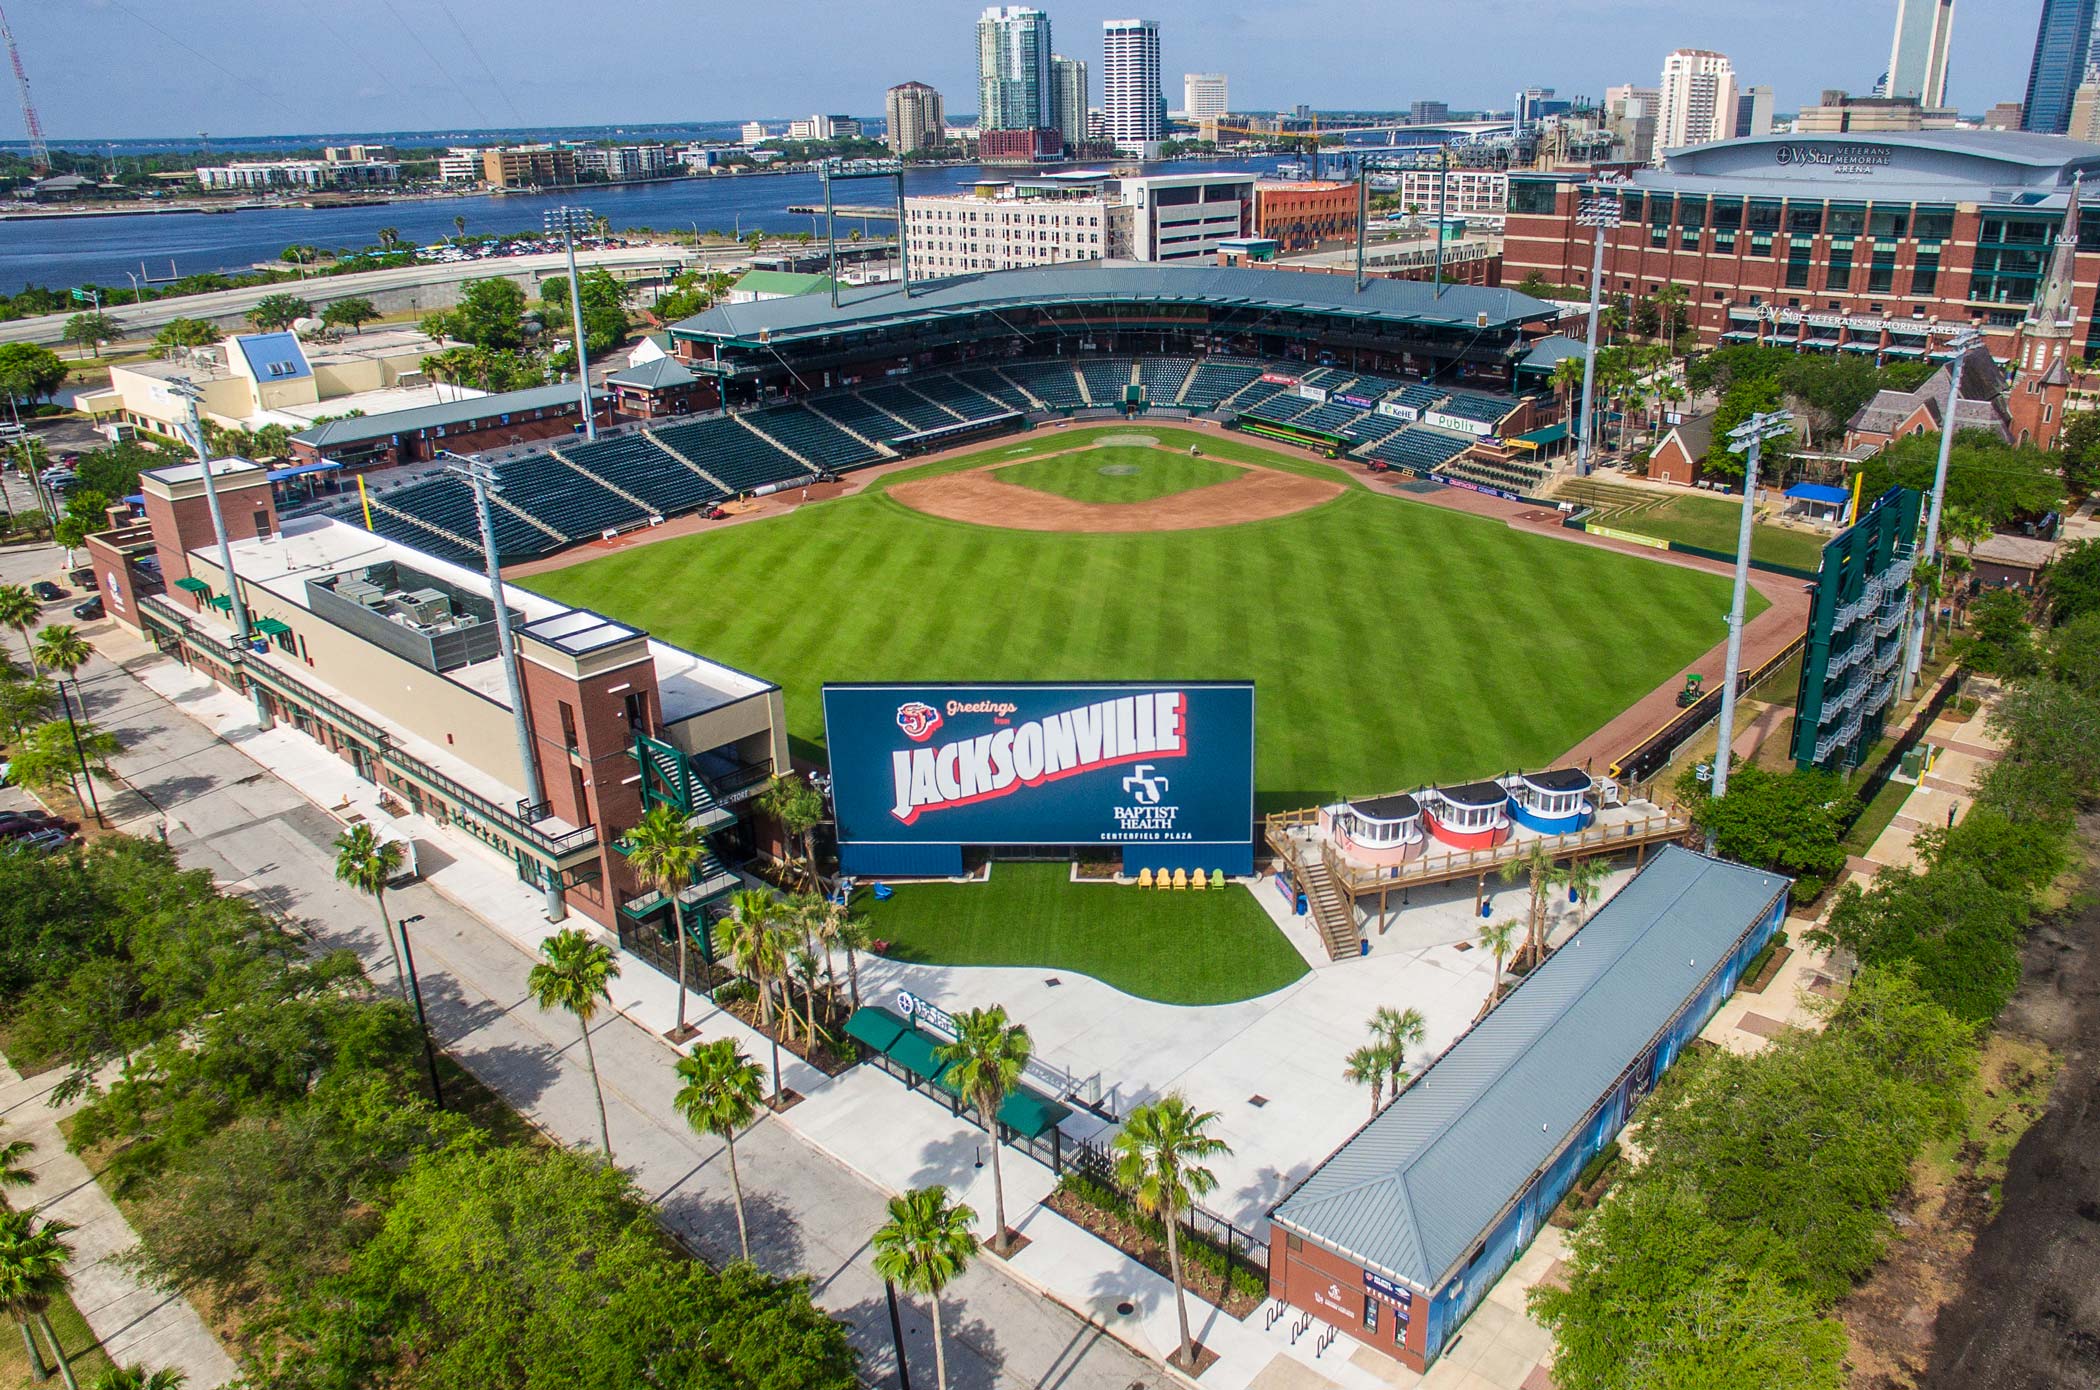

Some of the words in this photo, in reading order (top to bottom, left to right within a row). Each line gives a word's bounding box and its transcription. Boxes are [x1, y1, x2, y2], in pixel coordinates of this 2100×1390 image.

[1792, 147, 1834, 167] VyStar
[1837, 147, 1891, 155] VETERANS
[1835, 156, 1890, 165] MEMORIAL
[1834, 165, 1872, 174] ARENA
[1769, 306, 1804, 321] VStar
[1808, 313, 1864, 327] VETERANS
[1867, 319, 1924, 333] MEMORIAL
[1928, 325, 1961, 335] AREN
[1392, 408, 1413, 419] KeHE
[1438, 415, 1475, 433] Publix
[946, 700, 1018, 717] Greetings
[890, 691, 1187, 826] JACKSONVILLE
[1113, 806, 1179, 819] BAPTIST
[1120, 819, 1172, 829] HEALTH
[1100, 832, 1160, 840] CENTERFIELD
[1164, 832, 1193, 840] PLAZA
[1366, 1286, 1408, 1311] TICKETS
